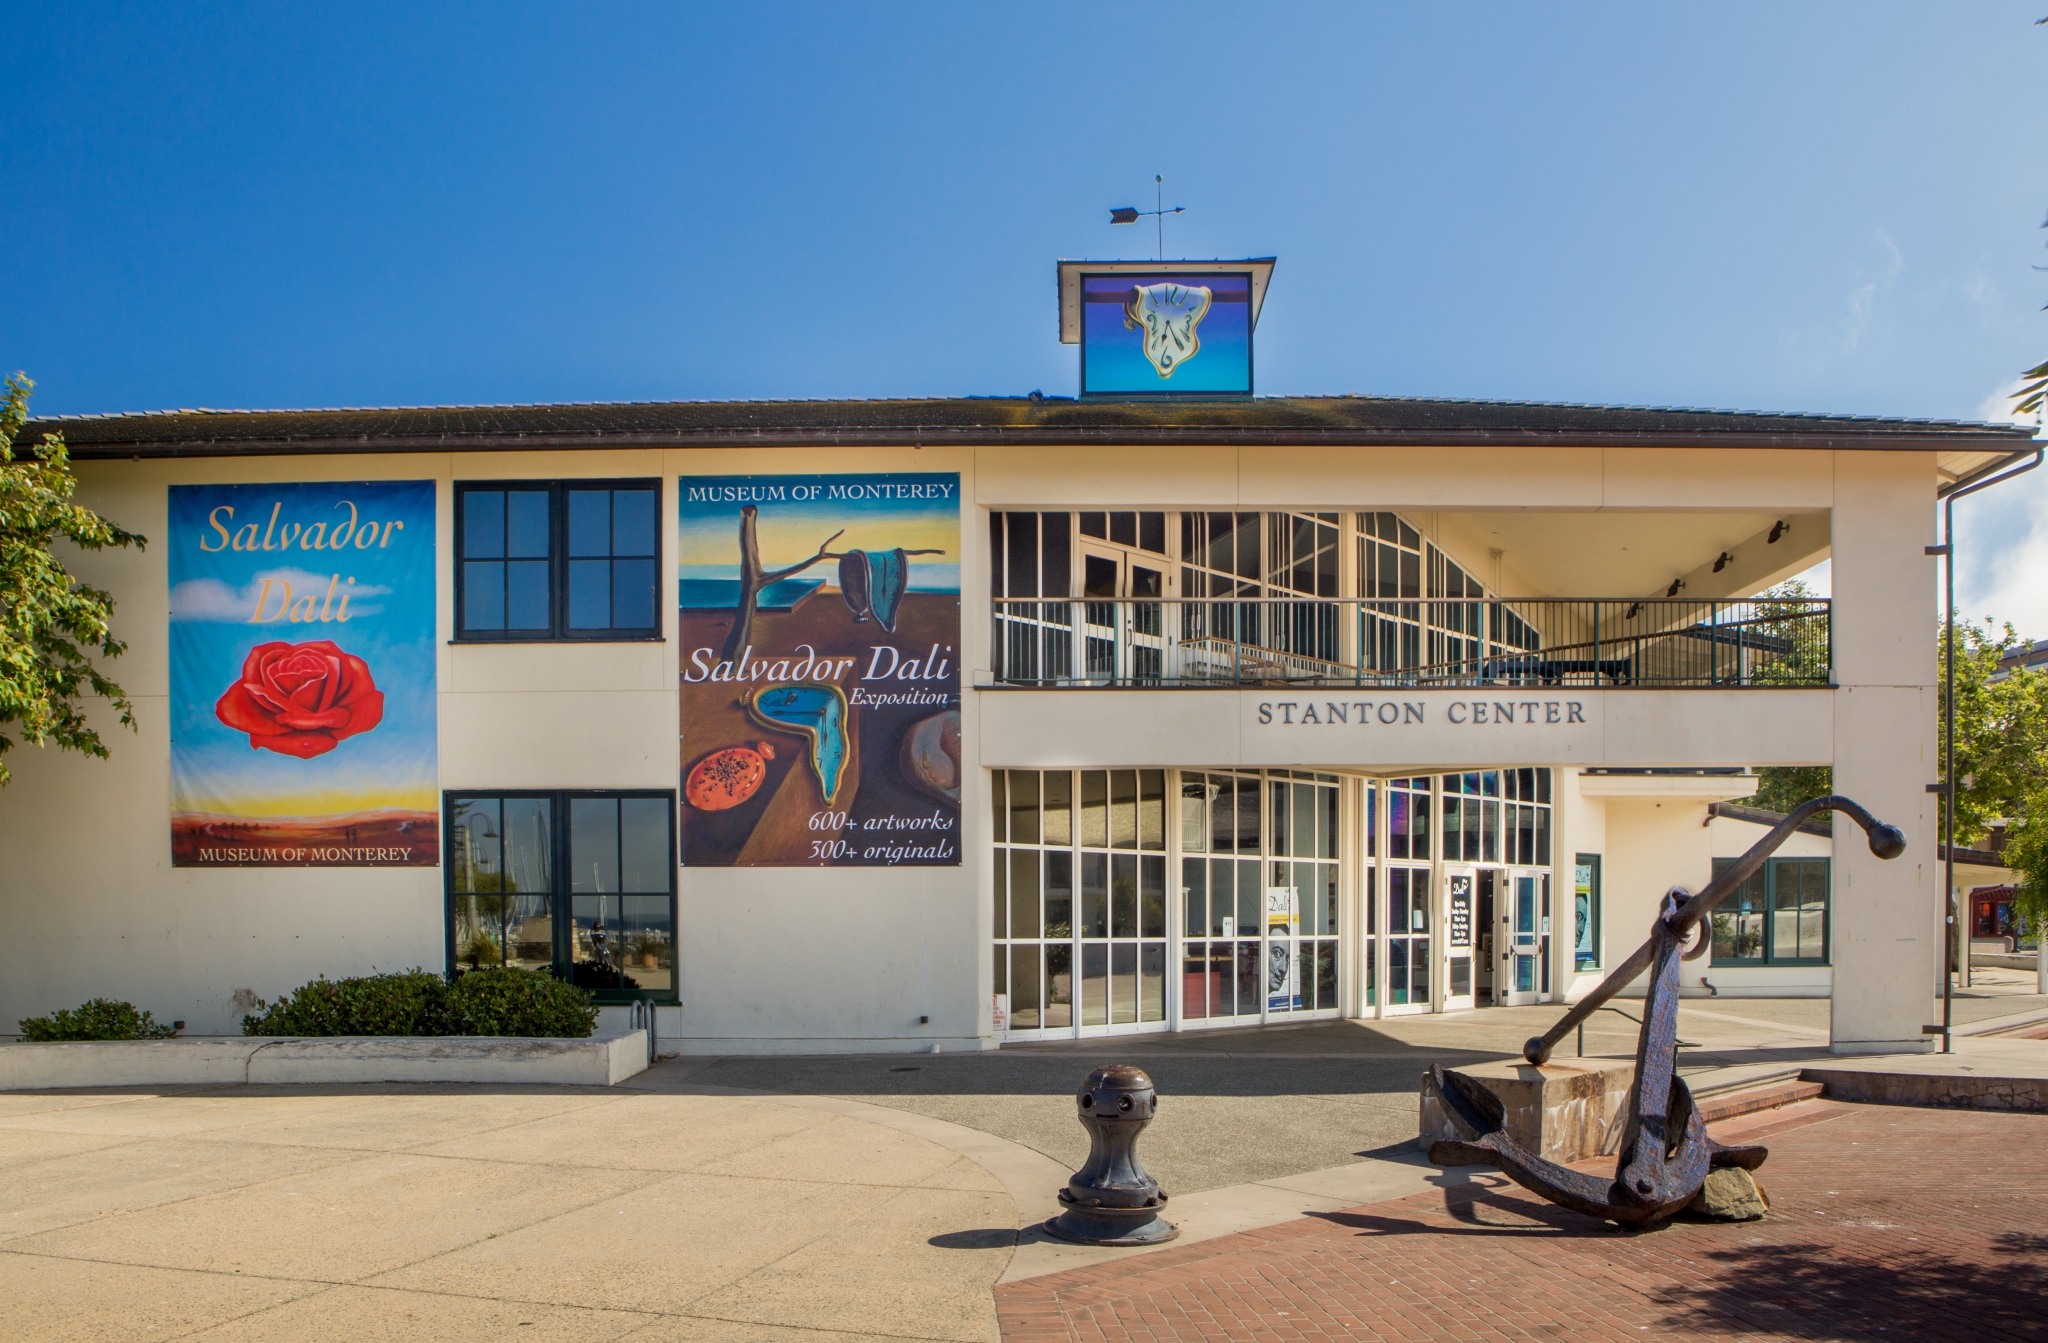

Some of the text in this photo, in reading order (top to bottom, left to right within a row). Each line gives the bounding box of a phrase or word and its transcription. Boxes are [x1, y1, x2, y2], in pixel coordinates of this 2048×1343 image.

[688, 483, 954, 501] MUSEUM OF MONTEREY
[200, 500, 404, 552] Salvador
[247, 573, 356, 624] Dali
[684, 643, 951, 683] Salvador Dali
[849, 687, 948, 711] Exposition
[1258, 701, 1587, 725] STANTON CENTER
[808, 809, 954, 831] 600+ artworks
[198, 847, 412, 861] MUSEUM OF MONTEREY
[808, 838, 954, 863] 300+ originals
